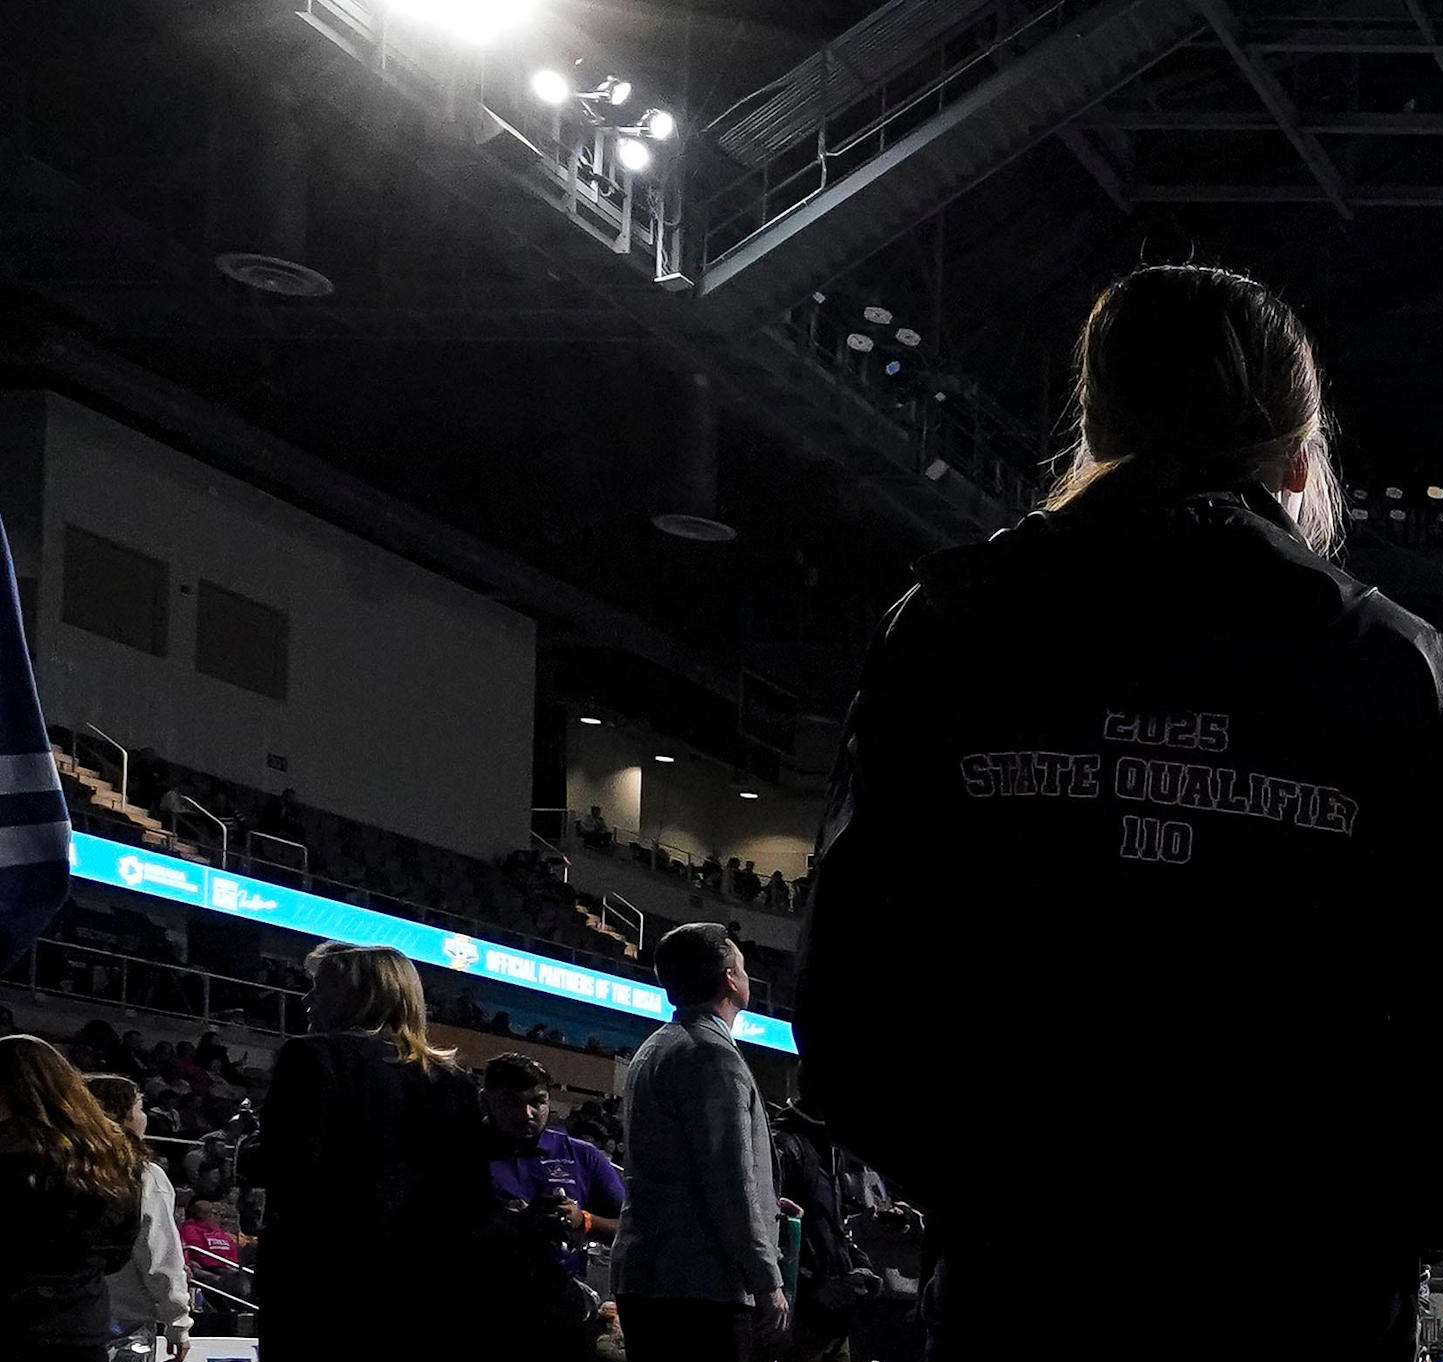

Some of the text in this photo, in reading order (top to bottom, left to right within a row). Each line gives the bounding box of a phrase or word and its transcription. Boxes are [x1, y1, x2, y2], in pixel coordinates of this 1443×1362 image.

[1104, 708, 1229, 752] 2025
[960, 751, 1100, 798] STATE
[1120, 815, 1193, 864] 110
